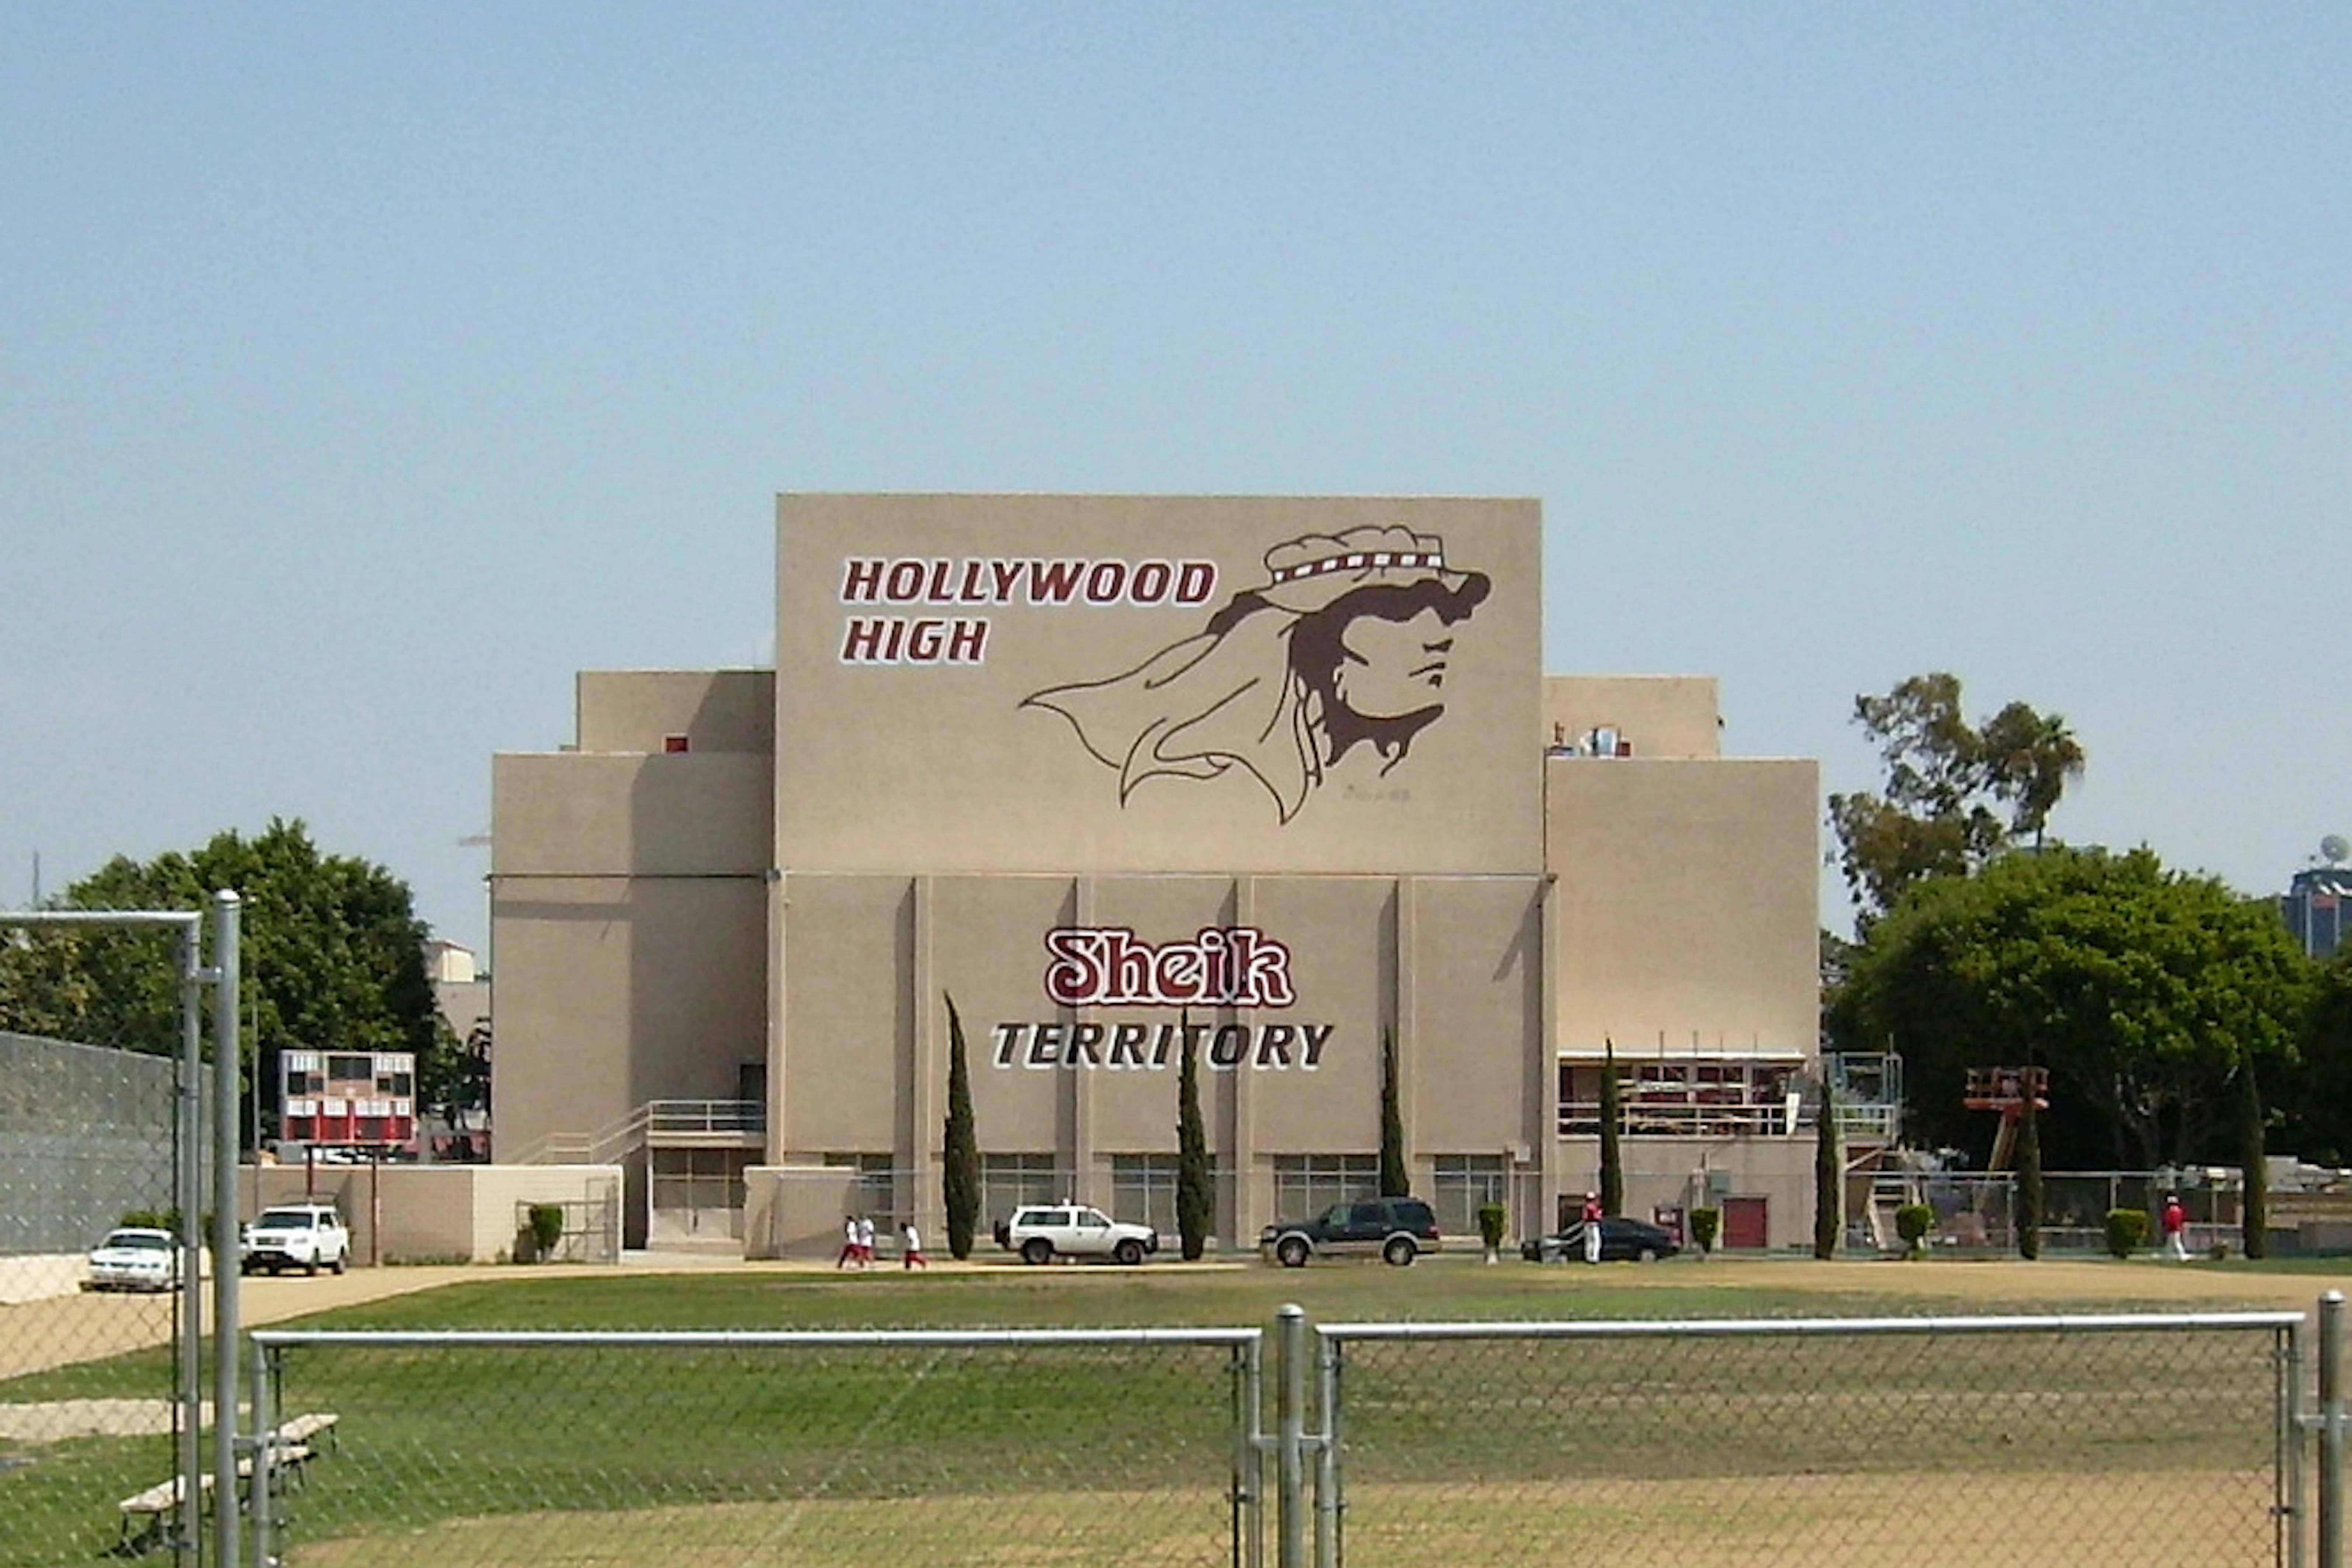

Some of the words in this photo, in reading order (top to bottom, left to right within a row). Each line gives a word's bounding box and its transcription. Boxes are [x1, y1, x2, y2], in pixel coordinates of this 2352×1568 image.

[841, 557, 1217, 606] HOLLYWOOD
[841, 617, 990, 664] HIGH
[1045, 927, 1295, 1007] Sheik
